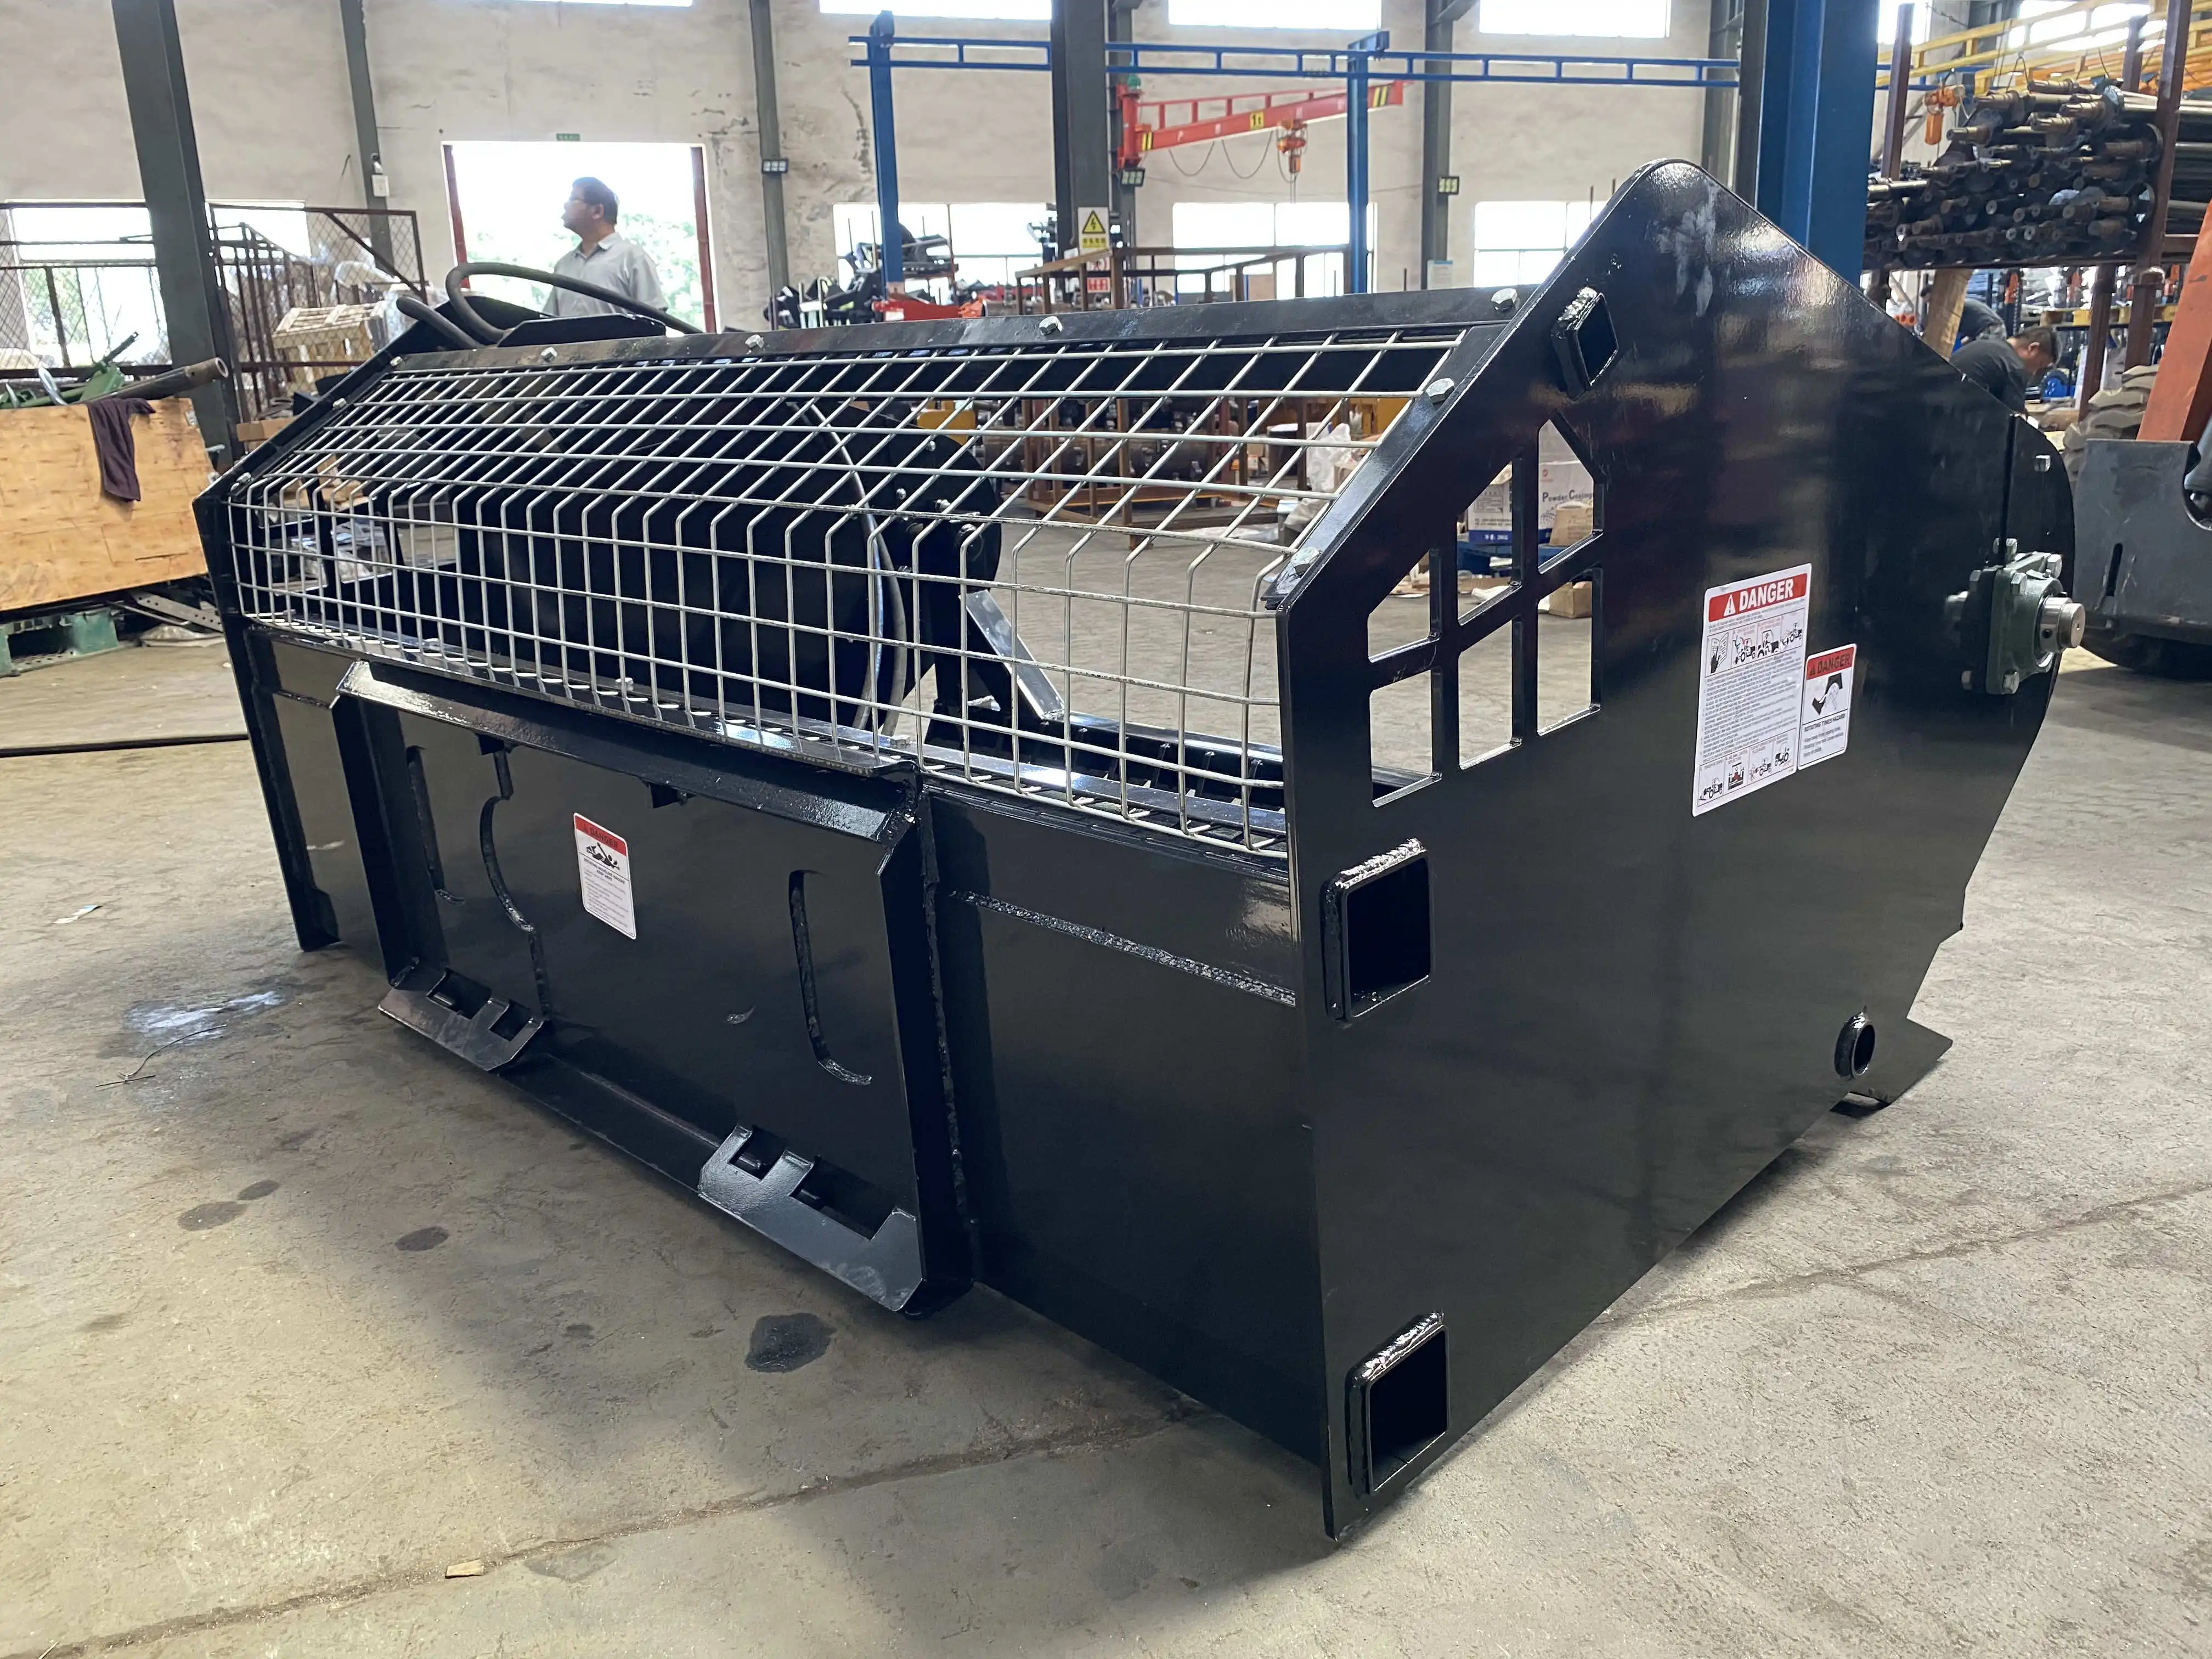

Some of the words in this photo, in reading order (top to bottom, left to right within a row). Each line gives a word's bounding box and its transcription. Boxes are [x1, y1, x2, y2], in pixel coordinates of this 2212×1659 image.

[1542, 492, 1568, 502] Powder
[1739, 579, 1793, 611] DANGER
[1817, 653, 1851, 674] DANGER
[590, 827, 618, 849] DANGER
